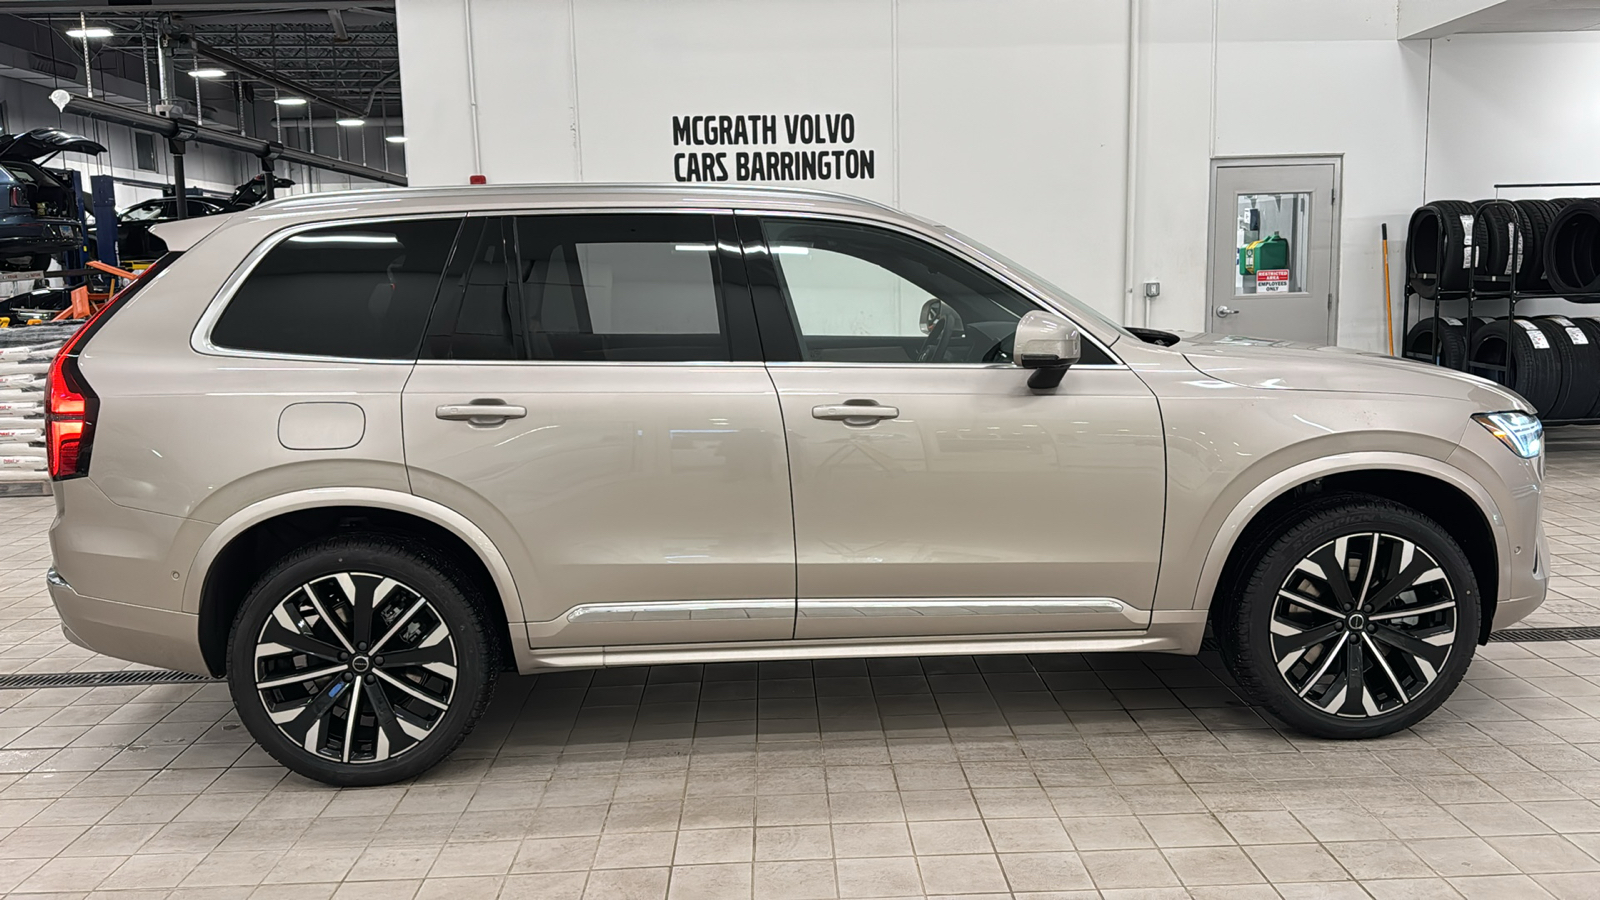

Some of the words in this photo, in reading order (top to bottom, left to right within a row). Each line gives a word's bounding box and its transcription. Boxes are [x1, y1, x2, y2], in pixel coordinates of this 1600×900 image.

[672, 115, 776, 145] MCGRATH
[784, 114, 854, 144] VOLVO
[674, 152, 729, 183] CARS
[736, 149, 875, 182] BARRINGTON
[1293, 514, 1375, 548] SCORPION
